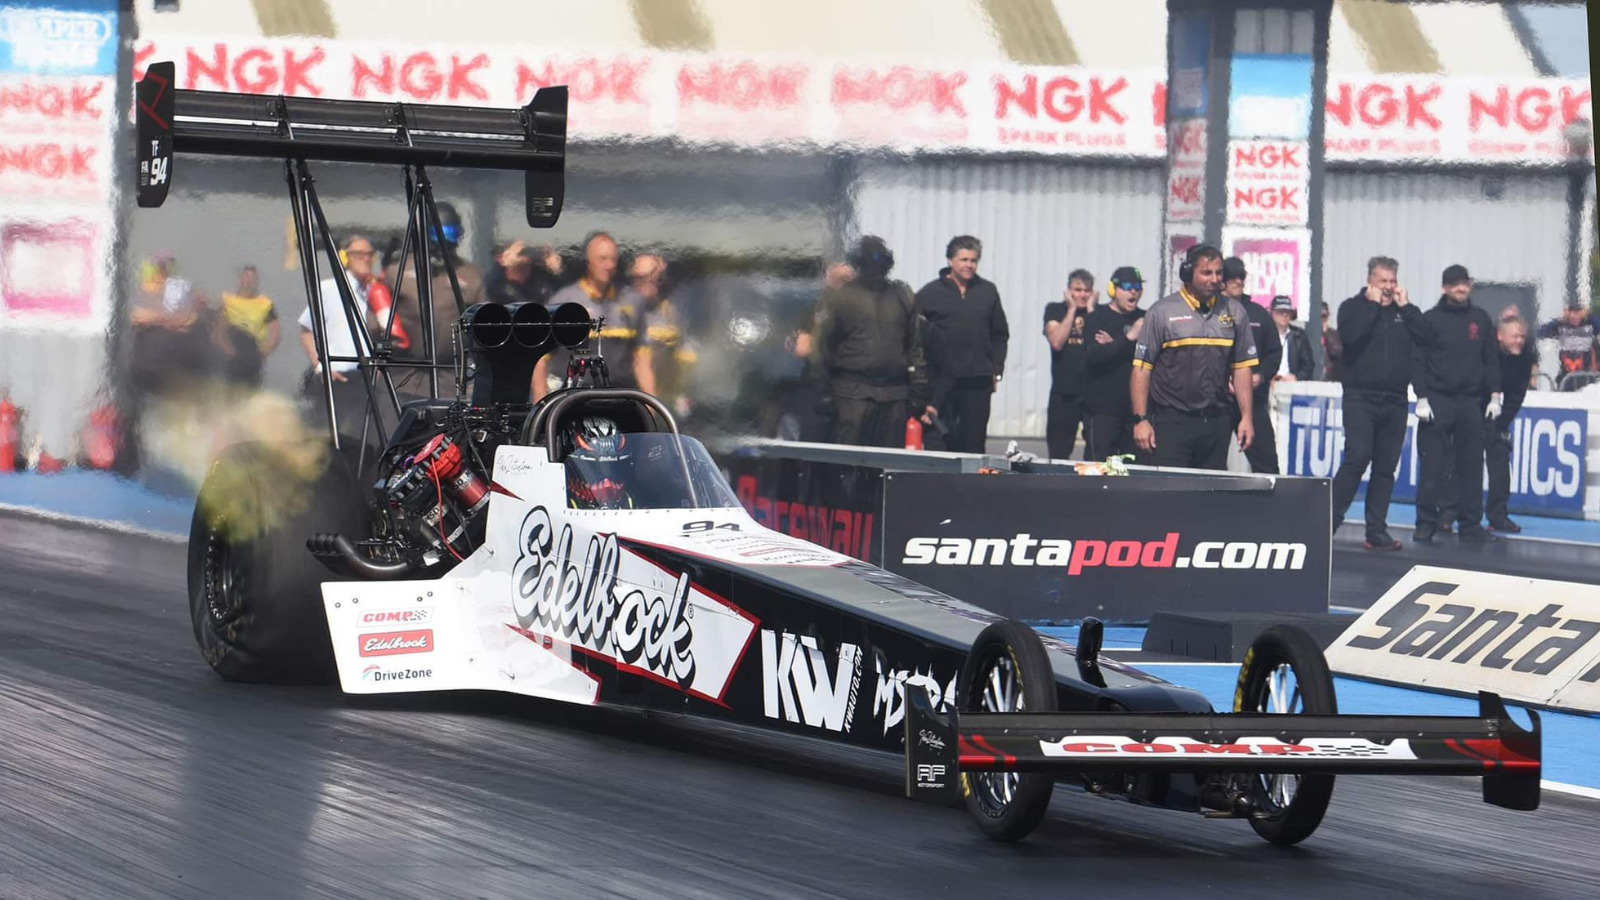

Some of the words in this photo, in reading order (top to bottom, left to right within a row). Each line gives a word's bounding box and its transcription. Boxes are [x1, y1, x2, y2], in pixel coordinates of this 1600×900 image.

[186, 44, 326, 97] NGK
[351, 52, 490, 101] NGK
[994, 74, 1128, 125] NGK
[1469, 85, 1592, 132] NGK
[150, 156, 168, 186] 94
[1235, 146, 1300, 168] NGK
[1234, 186, 1299, 209] NGK
[682, 520, 741, 532] 94
[902, 532, 1307, 576] santapod.com
[512, 505, 697, 691] Edelbock
[363, 611, 413, 623] COMP
[1346, 580, 1600, 676] Santa
[363, 635, 428, 652] Edelbrock
[374, 668, 432, 682] DriveZone
[761, 629, 857, 732] KW
[1062, 742, 1315, 755] COMP
